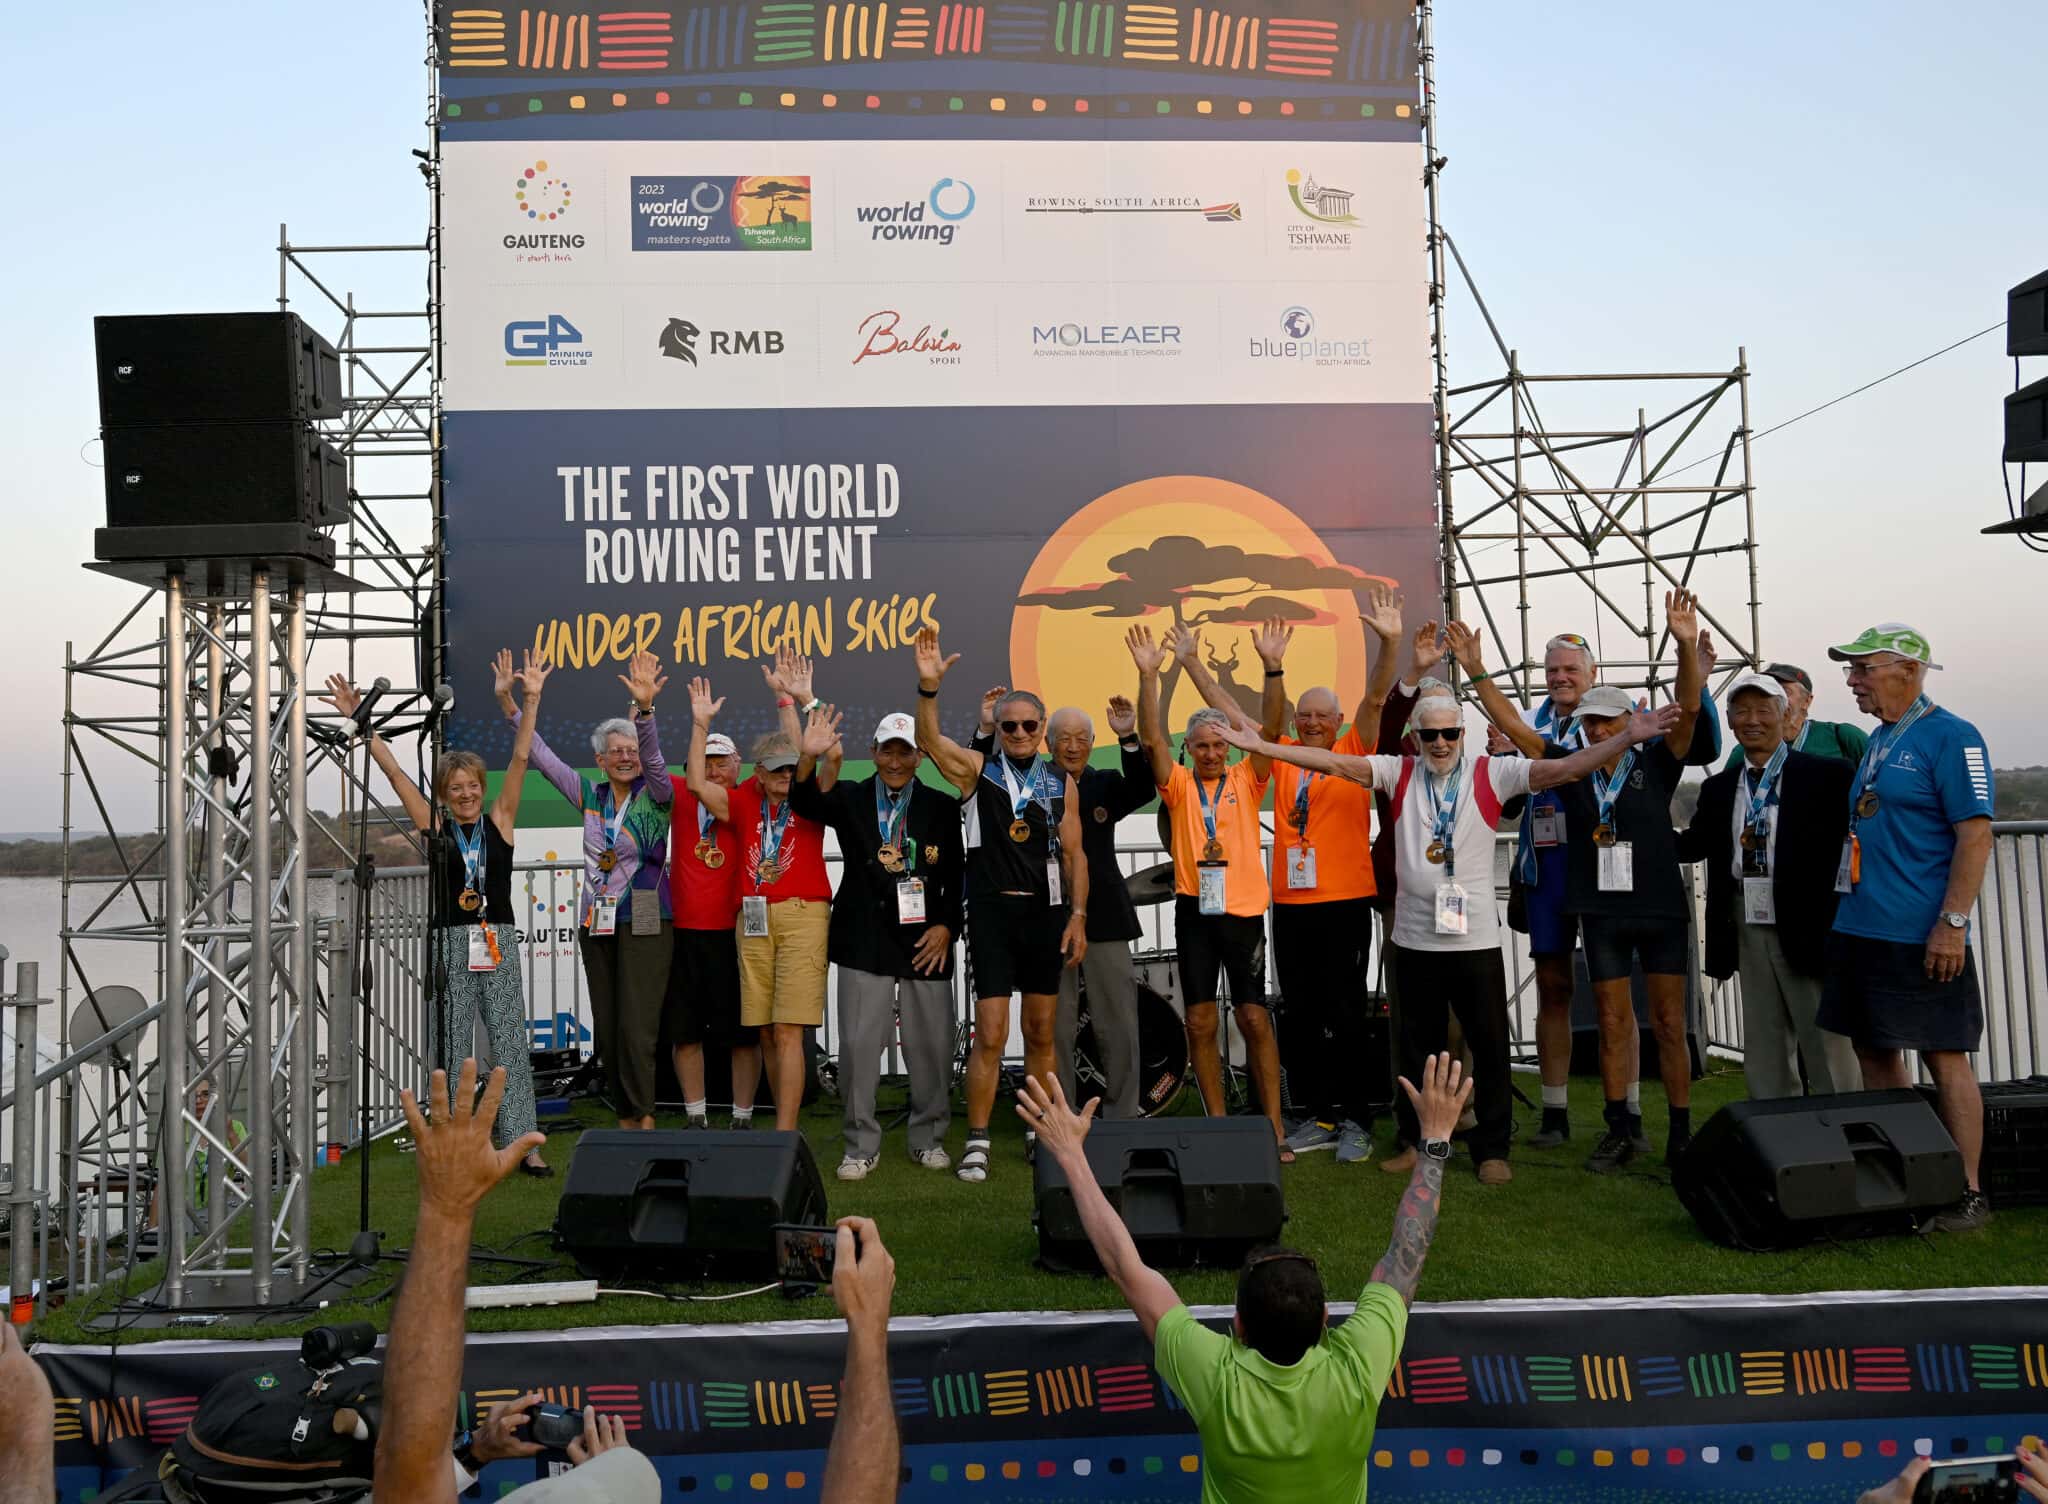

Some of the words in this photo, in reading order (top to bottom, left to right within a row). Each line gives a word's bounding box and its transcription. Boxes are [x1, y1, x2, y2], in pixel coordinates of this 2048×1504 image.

[638, 184, 665, 195] 2023
[639, 198, 689, 214] world
[1028, 197, 1087, 207] ROWING
[1095, 197, 1143, 207] SOUTH
[1151, 197, 1201, 207] AFRICA
[857, 201, 926, 222] world
[649, 215, 709, 231] rowing
[1287, 224, 1304, 232] CITY
[744, 227, 776, 236] Tshwane
[872, 224, 955, 245] rowing
[503, 234, 585, 249] GAUTENG
[647, 234, 691, 245] masters
[692, 234, 731, 246] regatta
[756, 235, 781, 244] South
[782, 235, 807, 244] Africa
[1287, 233, 1352, 244] TSHWANE
[1032, 323, 1182, 347] MOLEAER
[709, 330, 785, 355] RMB
[929, 357, 961, 365] SPORT
[118, 366, 133, 375] RCF
[126, 475, 141, 484] RCF
[557, 466, 632, 521] THE
[646, 465, 754, 520] FIRST
[766, 464, 900, 519] WORLD
[585, 527, 740, 584] ROWING
[755, 525, 877, 582] EVENT
